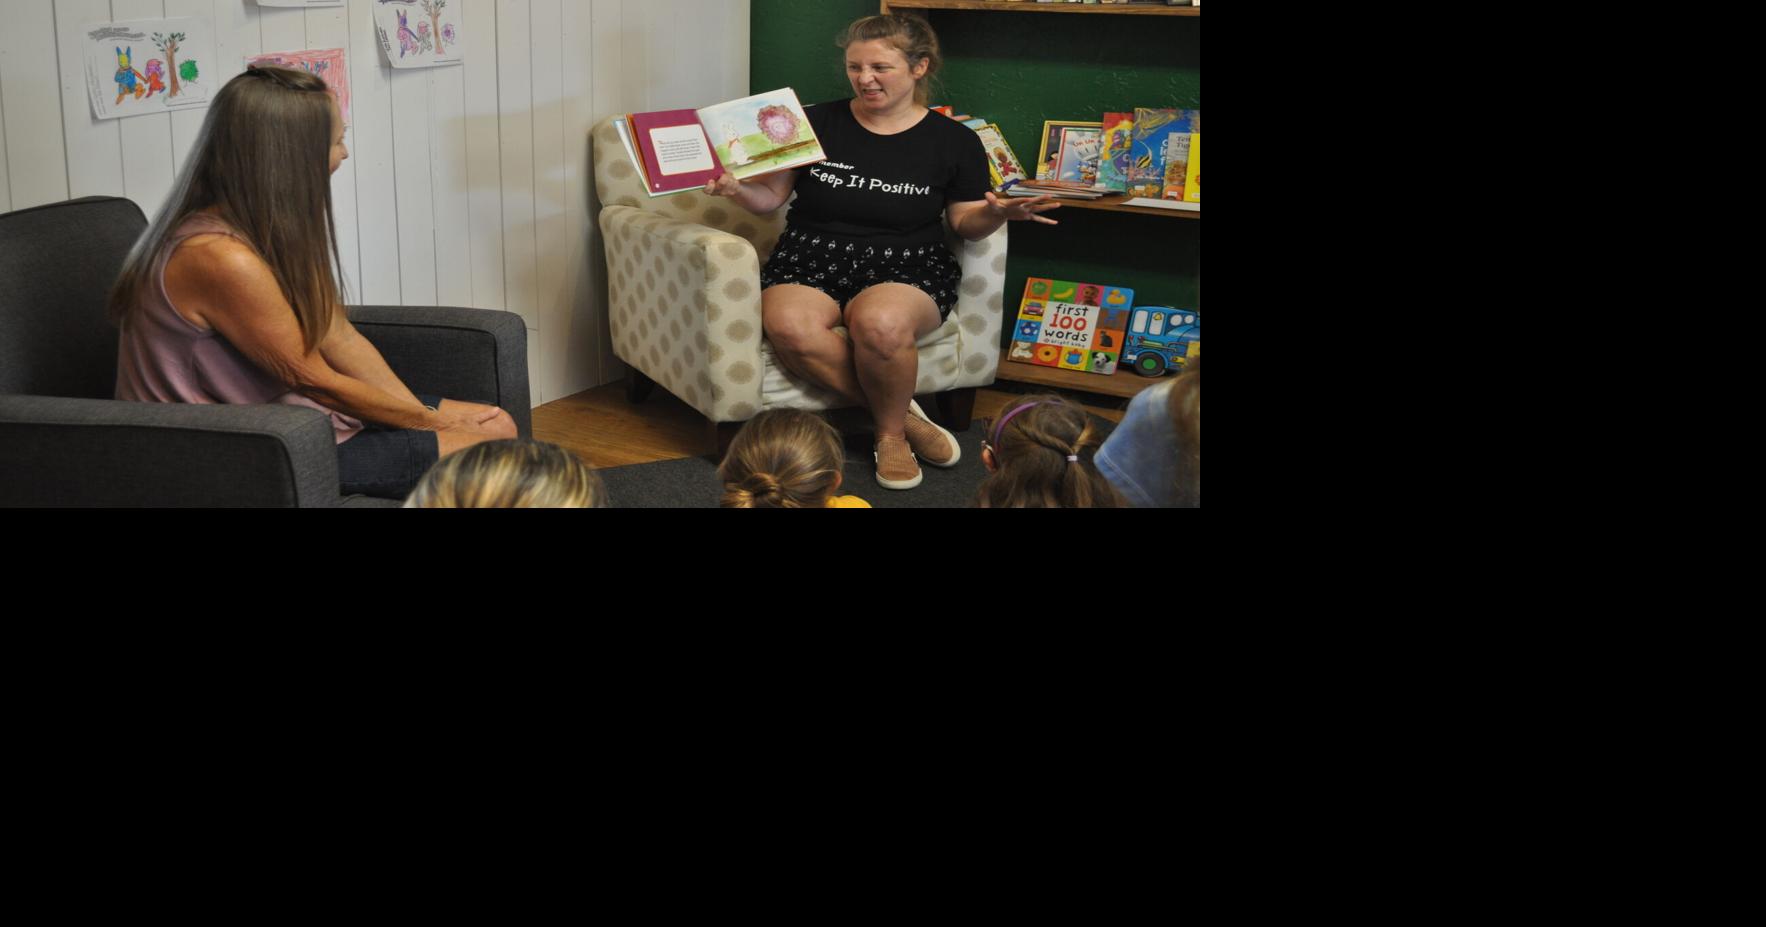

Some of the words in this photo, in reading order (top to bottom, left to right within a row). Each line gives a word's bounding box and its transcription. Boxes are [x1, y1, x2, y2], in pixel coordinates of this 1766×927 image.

[809, 167, 843, 188] Keep
[846, 175, 865, 188] It
[1056, 303, 1089, 317] first
[1049, 313, 1087, 331] 100
[1044, 329, 1088, 342] words
